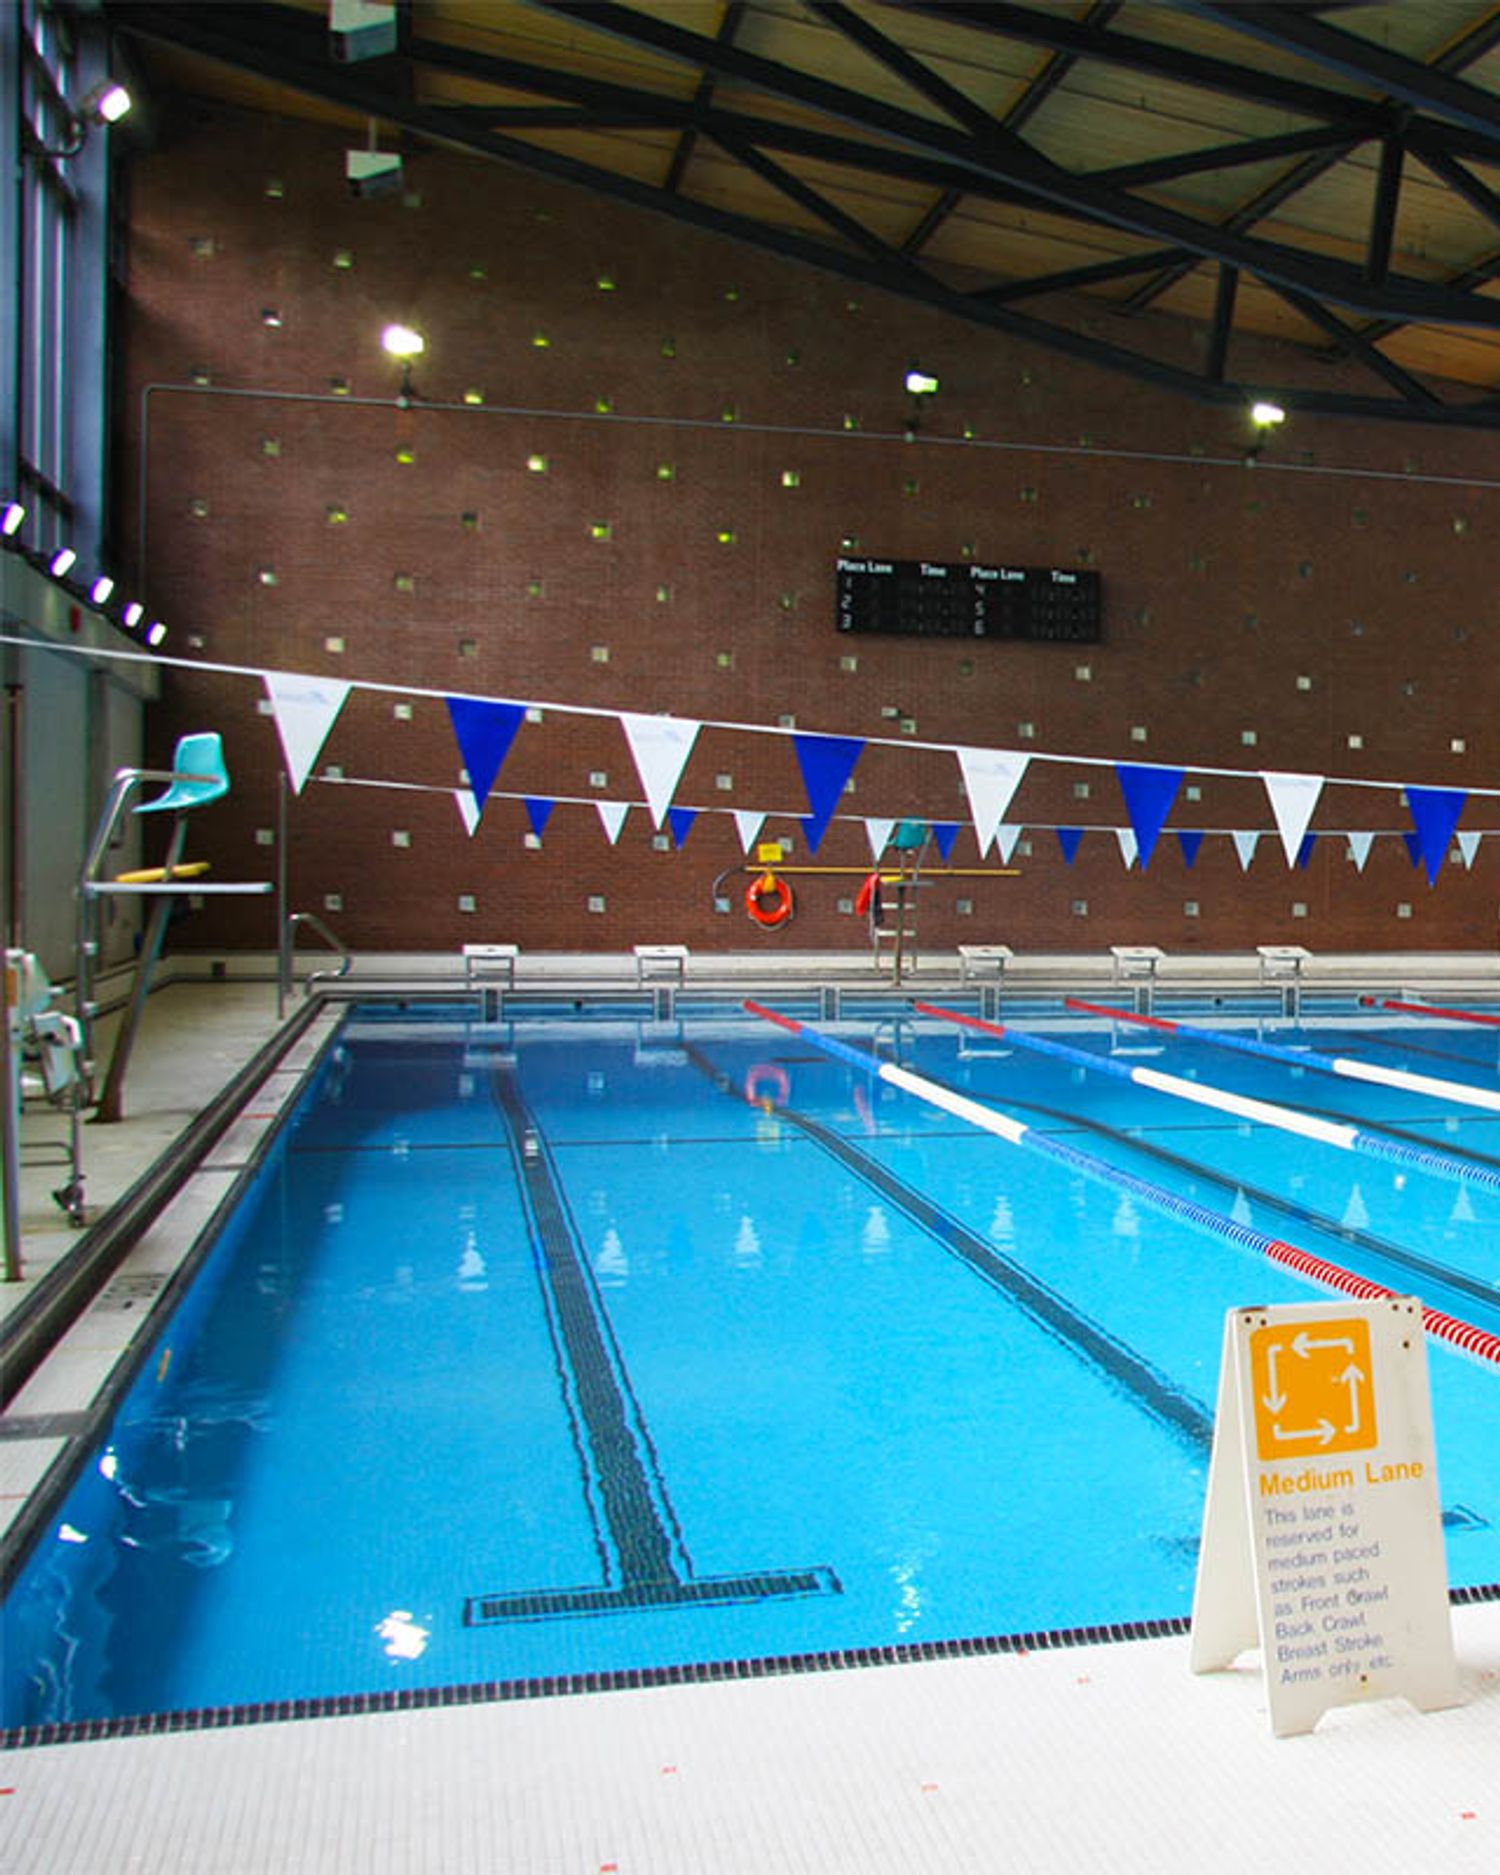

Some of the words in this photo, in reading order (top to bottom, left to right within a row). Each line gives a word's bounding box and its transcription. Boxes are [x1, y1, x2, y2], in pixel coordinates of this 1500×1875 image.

[837, 559, 866, 573] Place
[867, 560, 893, 574] Lane
[920, 563, 947, 577] Time
[970, 565, 998, 579] Place
[1000, 567, 1025, 581] Lane
[1051, 570, 1077, 584] Time
[841, 594, 852, 609] 2
[975, 601, 984, 616] 5
[842, 613, 852, 629] 3
[975, 619, 984, 635] 6
[1259, 1469, 1355, 1498] Medium
[1365, 1462, 1425, 1484] Lane
[1265, 1508, 1297, 1525] This
[1302, 1505, 1335, 1521] lane
[1341, 1503, 1354, 1516] is
[1266, 1525, 1333, 1548] reserved
[1340, 1522, 1359, 1538] for
[1268, 1552, 1328, 1571] medium
[1333, 1542, 1380, 1564] paced
[1271, 1575, 1326, 1595] strokes
[1333, 1566, 1370, 1584] such
[1274, 1603, 1294, 1617] as
[1301, 1593, 1340, 1613] Front
[1346, 1585, 1389, 1607] Crawl
[1275, 1620, 1313, 1640] Back
[1321, 1611, 1366, 1633] Crawl
[1277, 1640, 1328, 1663] Breast
[1334, 1632, 1384, 1654] Stroke
[1280, 1665, 1321, 1685] Arms
